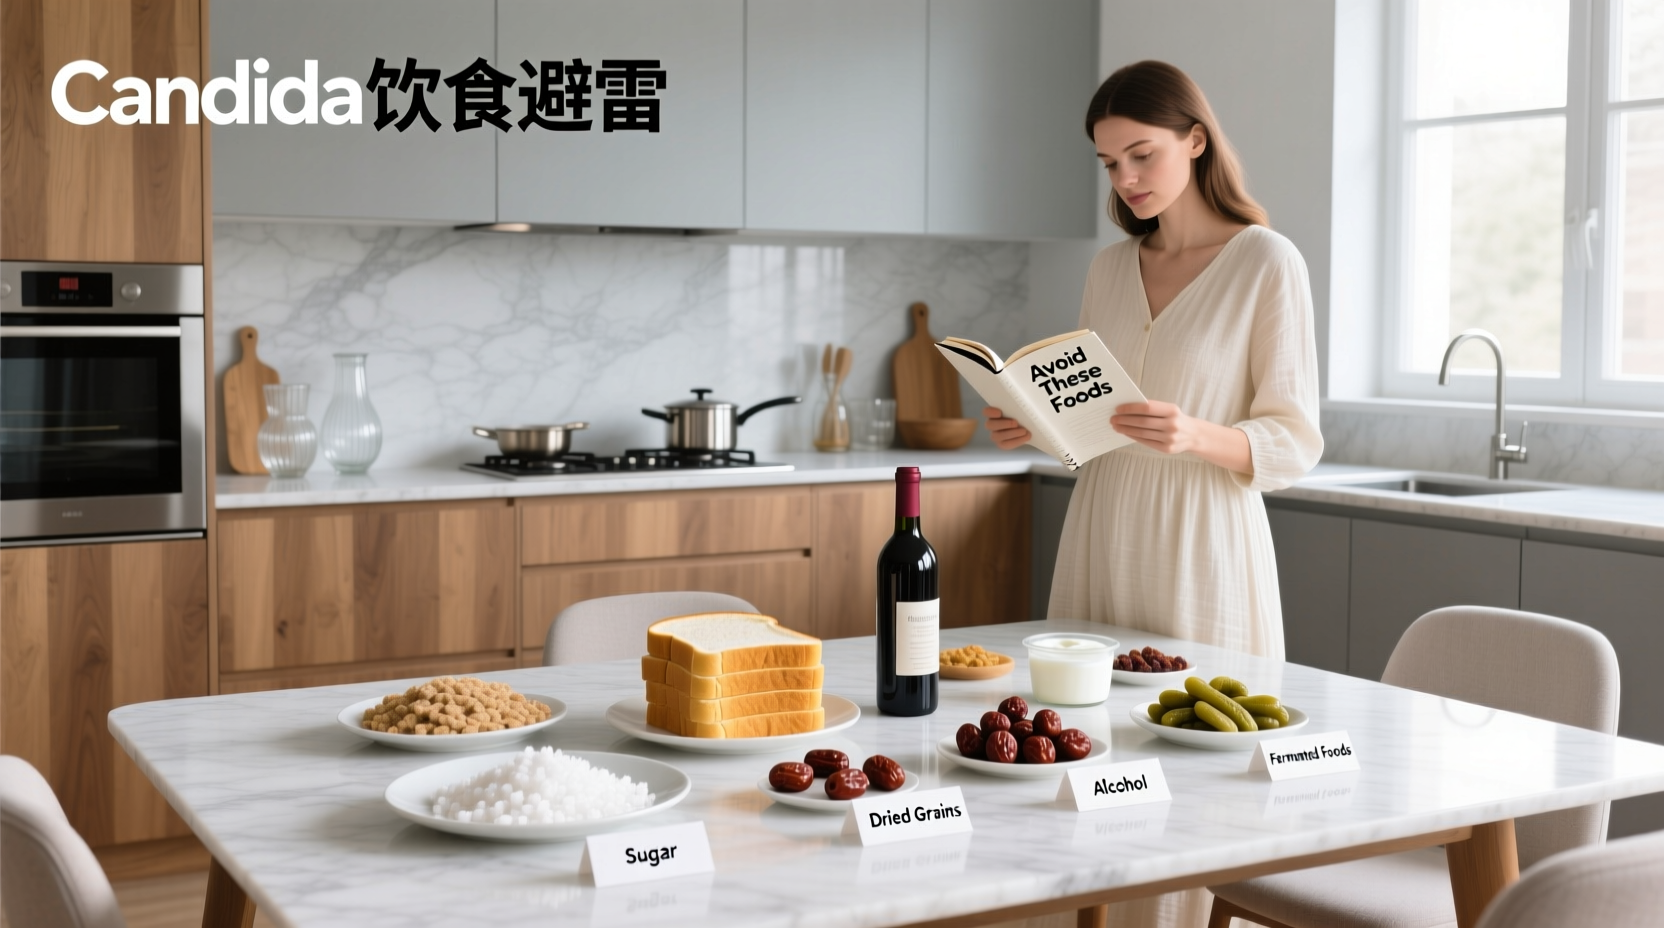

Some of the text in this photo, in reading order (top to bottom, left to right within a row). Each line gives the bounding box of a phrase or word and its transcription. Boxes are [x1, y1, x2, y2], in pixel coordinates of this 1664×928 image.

[1030, 346, 1088, 383] Avoid
[1038, 366, 1103, 396] These
[1049, 381, 1113, 414] Foods
[1320, 742, 1352, 759] Foods
[1094, 774, 1148, 796] Alcohol
[868, 802, 962, 828] Dried Grains
[625, 845, 678, 867] Sugar
